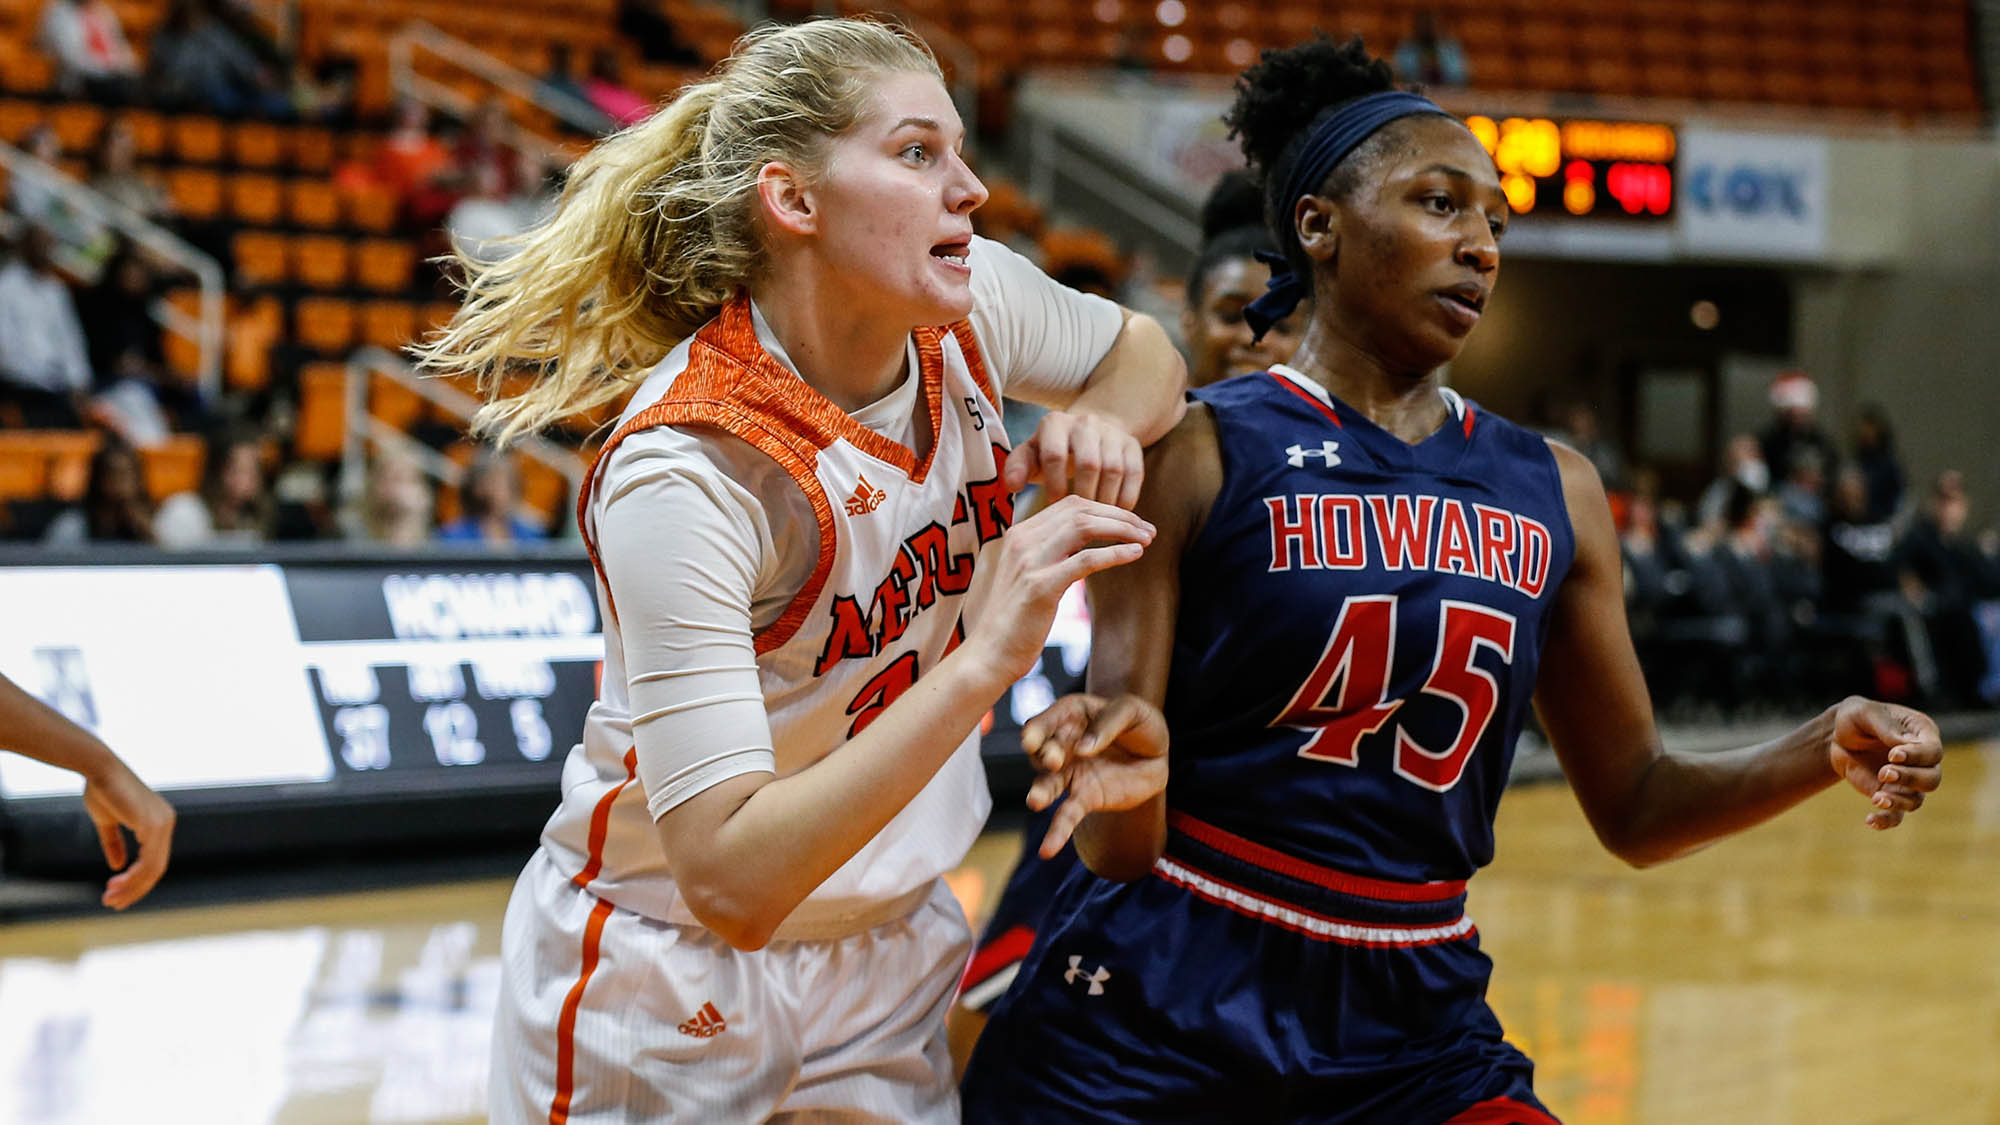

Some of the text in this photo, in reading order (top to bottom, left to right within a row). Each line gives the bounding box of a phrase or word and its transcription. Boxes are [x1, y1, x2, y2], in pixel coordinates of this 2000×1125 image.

[1263, 494, 1552, 600] HOWARD
[1265, 594, 1517, 793] 45
[677, 1022, 728, 1039] adida
